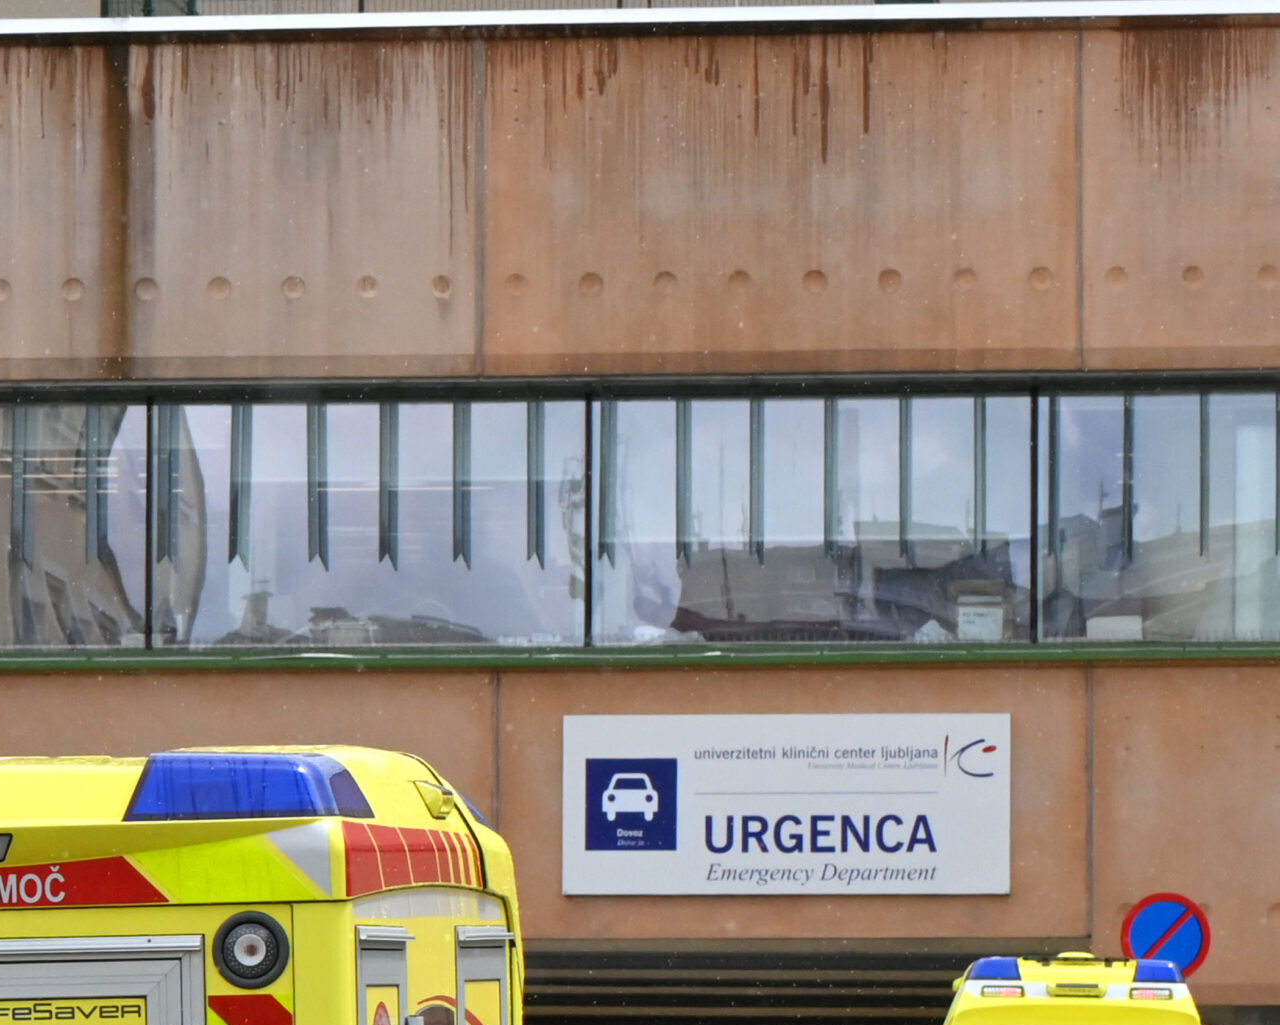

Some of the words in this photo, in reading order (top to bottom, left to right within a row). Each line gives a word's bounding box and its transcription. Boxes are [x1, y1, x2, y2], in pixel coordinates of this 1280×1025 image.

[694, 747, 776, 760] univerzitetni
[782, 747, 829, 760] klinični
[834, 748, 876, 760] center
[880, 747, 938, 762] ljubljana
[705, 814, 937, 853] URGENCA
[706, 862, 814, 886] Emergency
[821, 862, 937, 886] Department
